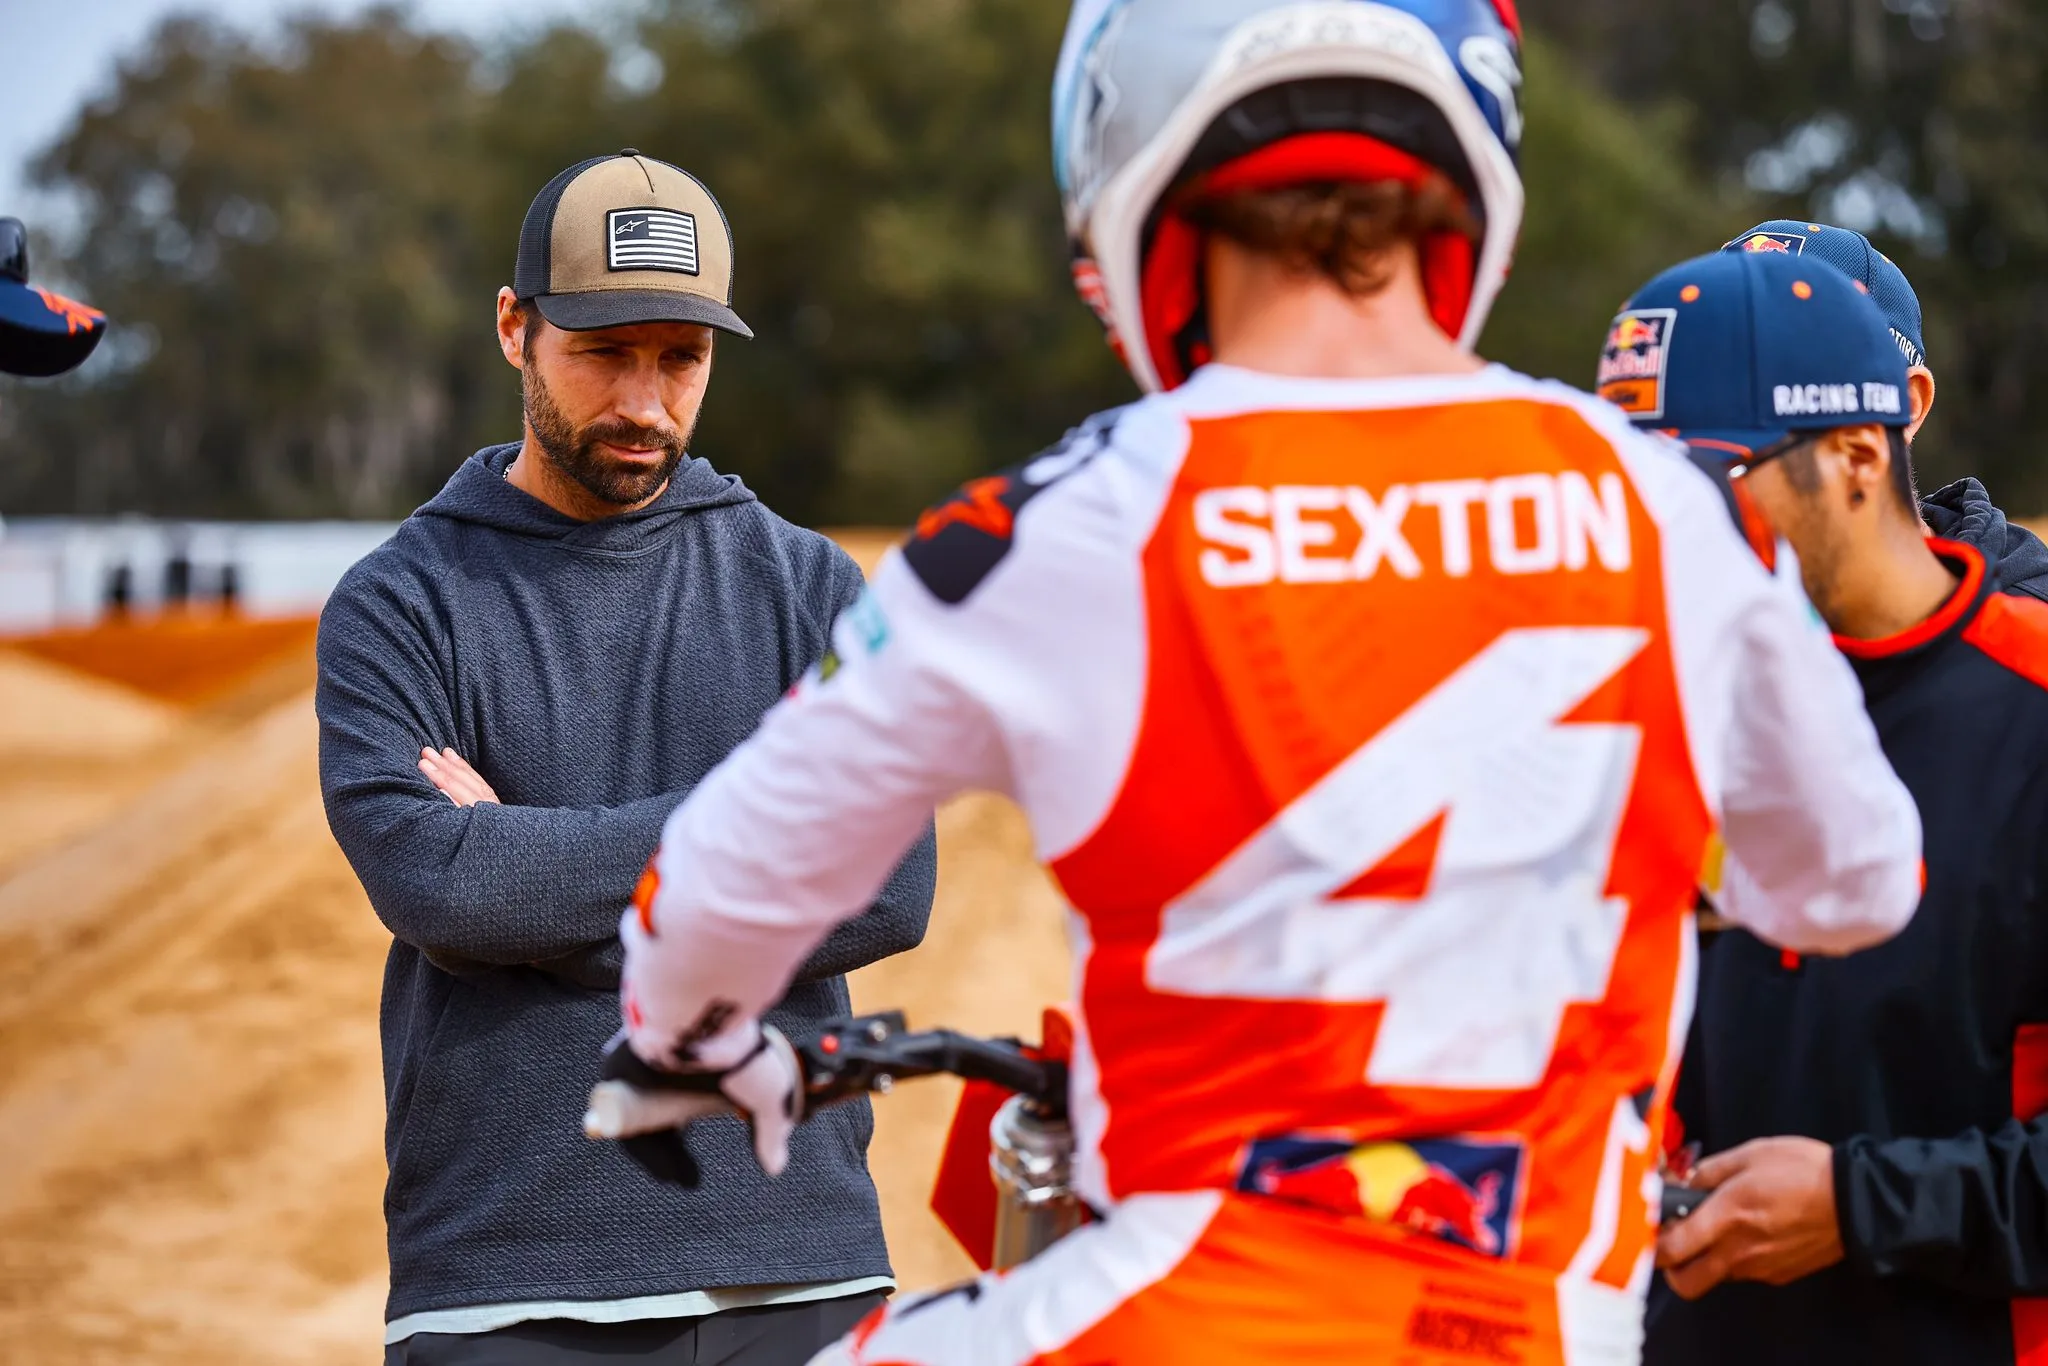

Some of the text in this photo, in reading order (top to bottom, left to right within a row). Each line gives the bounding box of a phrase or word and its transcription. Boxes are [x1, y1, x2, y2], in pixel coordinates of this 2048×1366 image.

[1773, 381, 1901, 416] RACING TEAM
[1194, 470, 1631, 587] SEXTON
[1144, 626, 1652, 1089] 4
